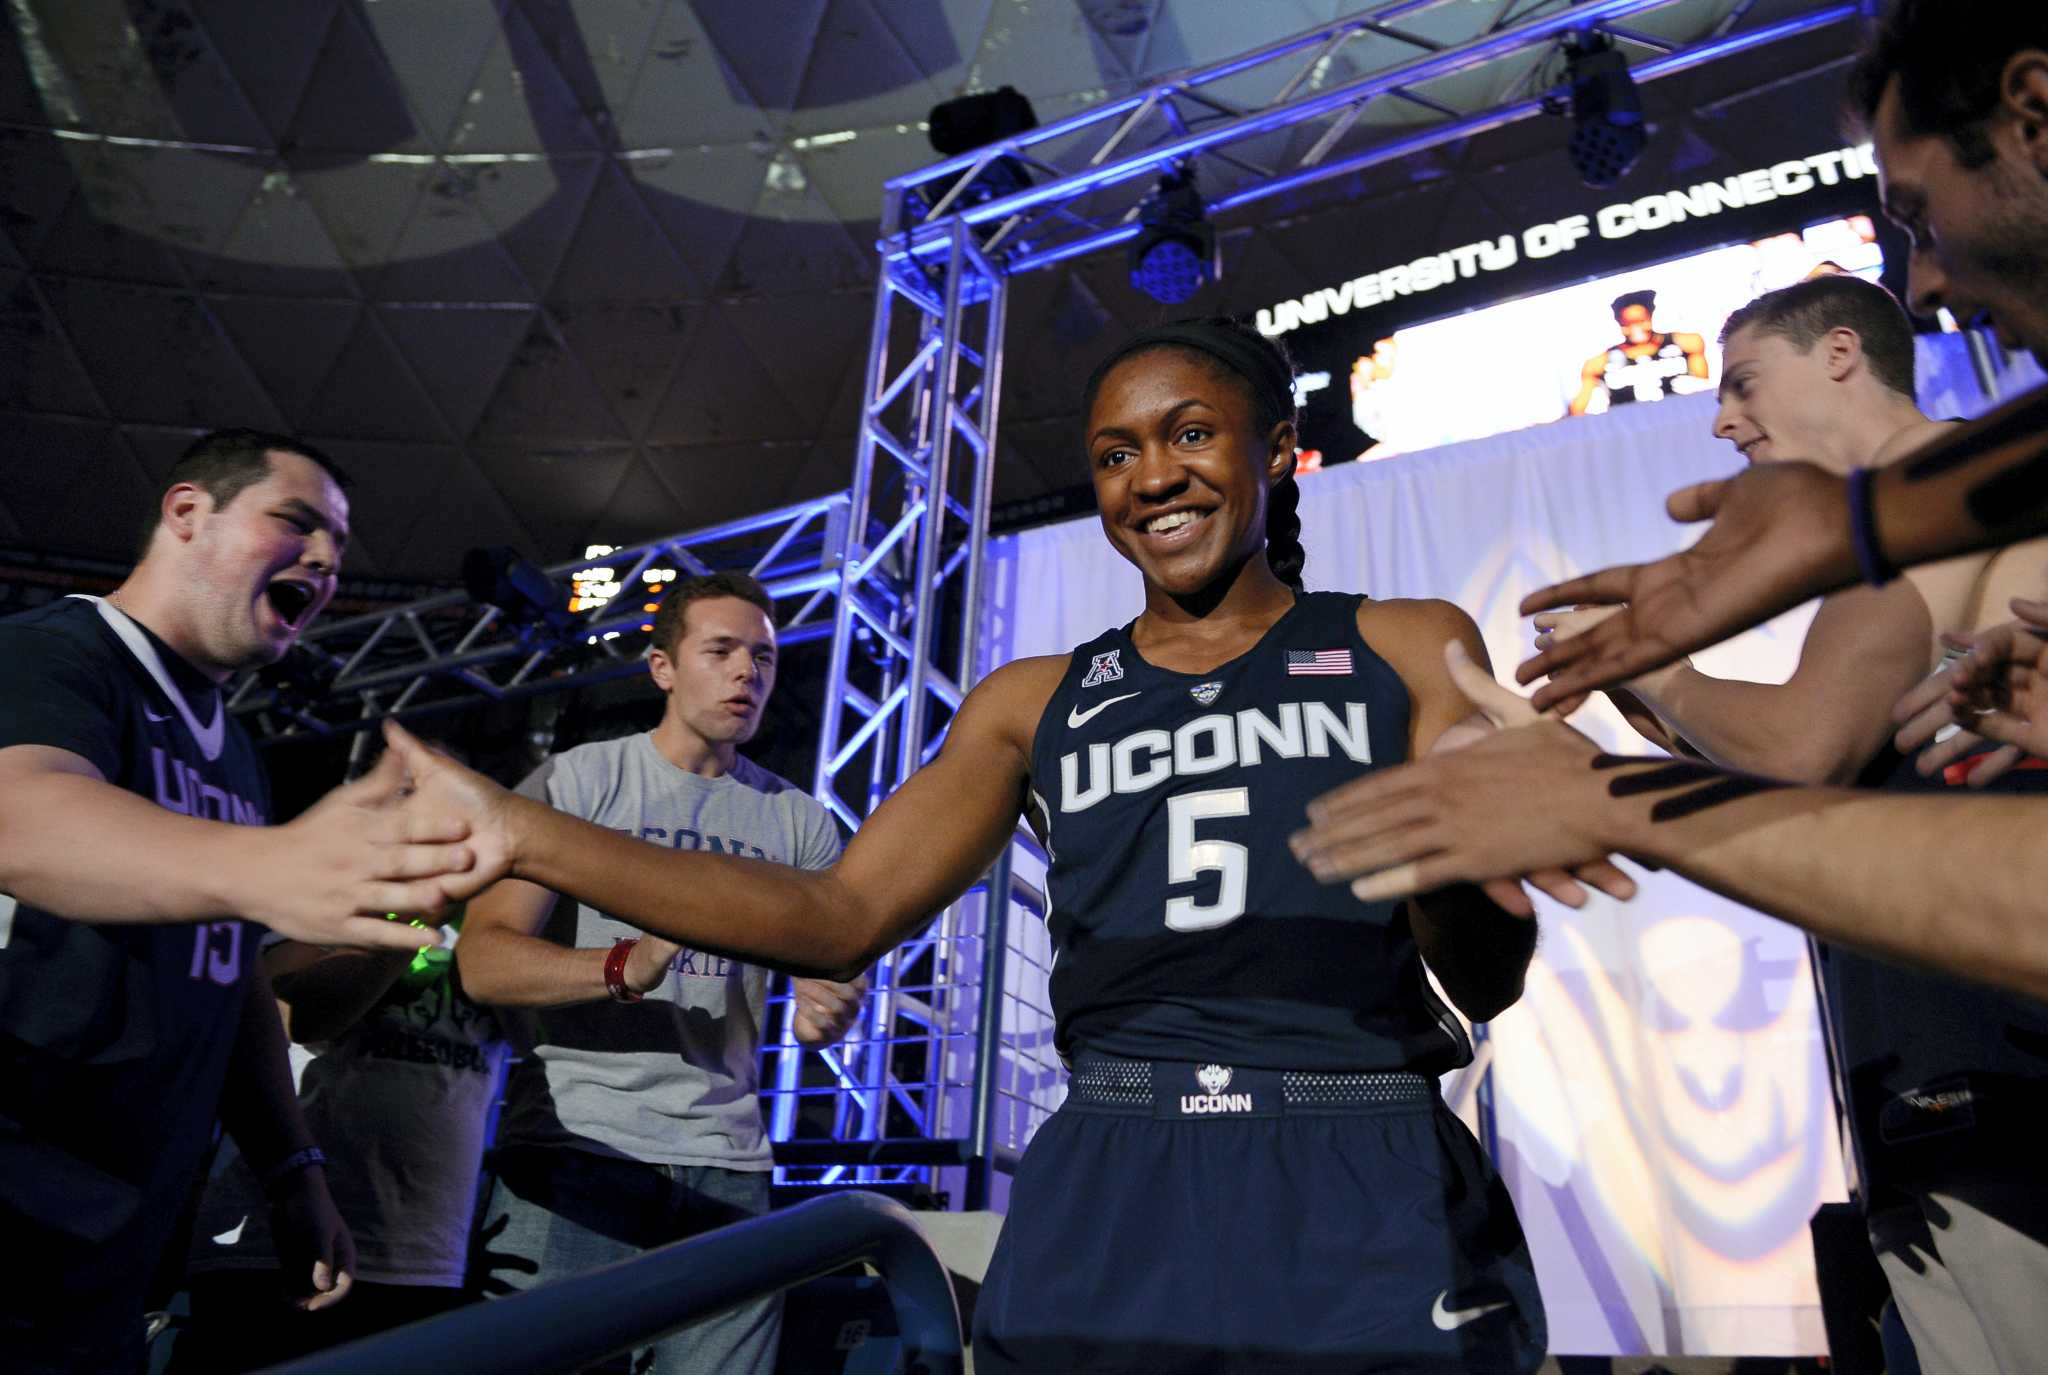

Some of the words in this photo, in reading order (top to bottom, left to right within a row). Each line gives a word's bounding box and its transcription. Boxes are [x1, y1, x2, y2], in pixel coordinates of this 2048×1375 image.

[1256, 235, 1518, 336] UNIVERSITY
[1523, 214, 1590, 259] OF
[1060, 702, 1372, 812] UCONN
[1165, 787, 1250, 932] 5
[1181, 1094, 1252, 1113] UCONN
